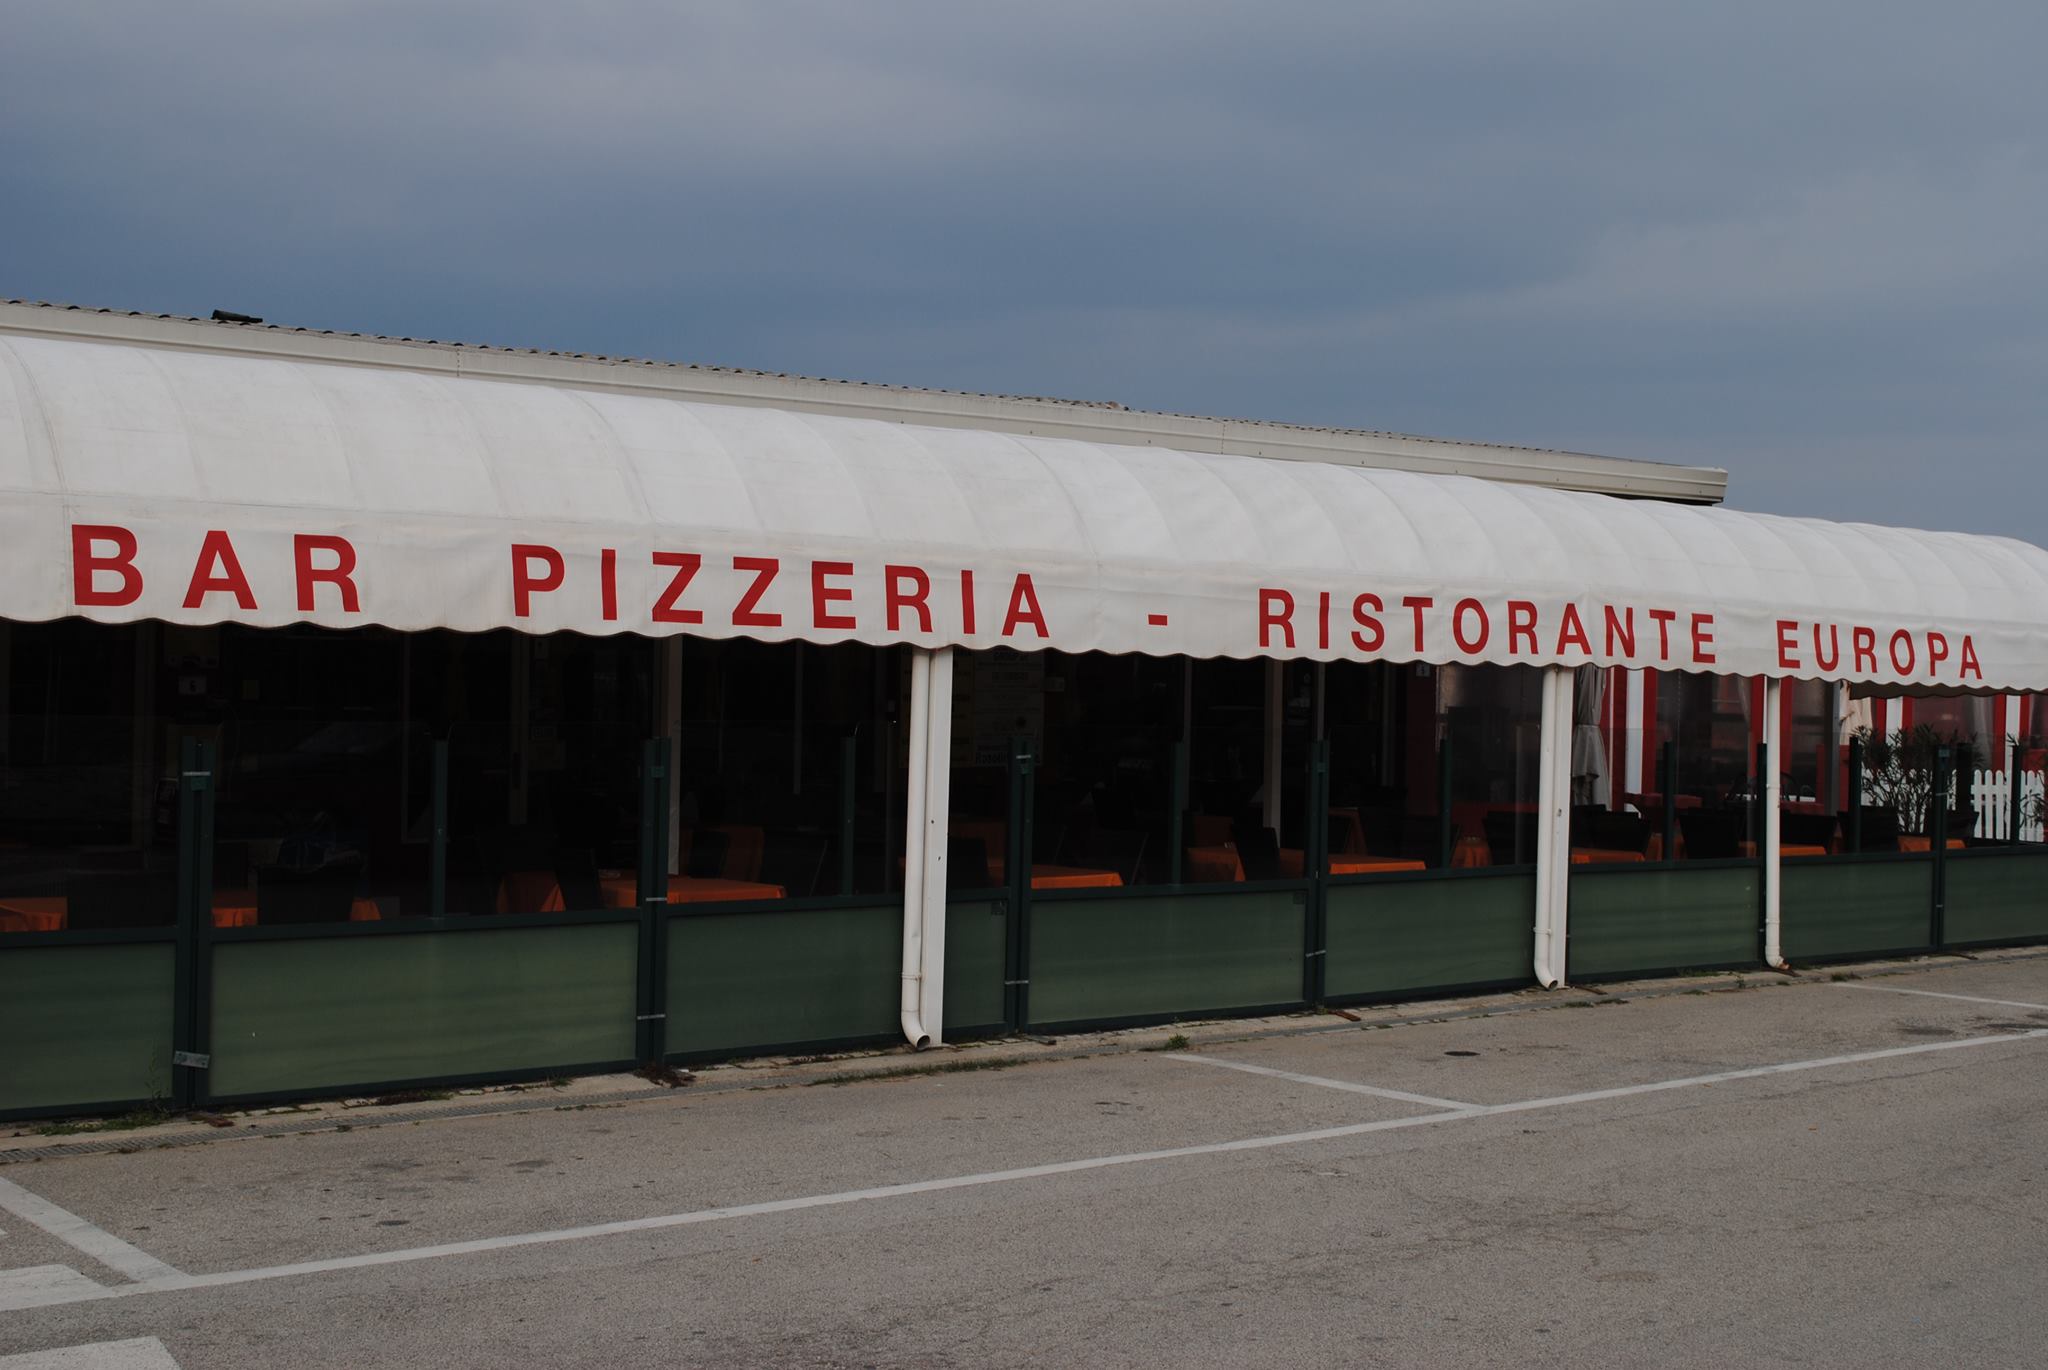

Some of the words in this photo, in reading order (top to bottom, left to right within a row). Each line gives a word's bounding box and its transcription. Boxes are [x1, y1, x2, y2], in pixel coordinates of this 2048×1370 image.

[72, 524, 361, 612] BAR
[511, 544, 1049, 638] PIZZERIA
[1258, 588, 1717, 664] RISTORANTE
[1776, 620, 1983, 680] EUROPA
